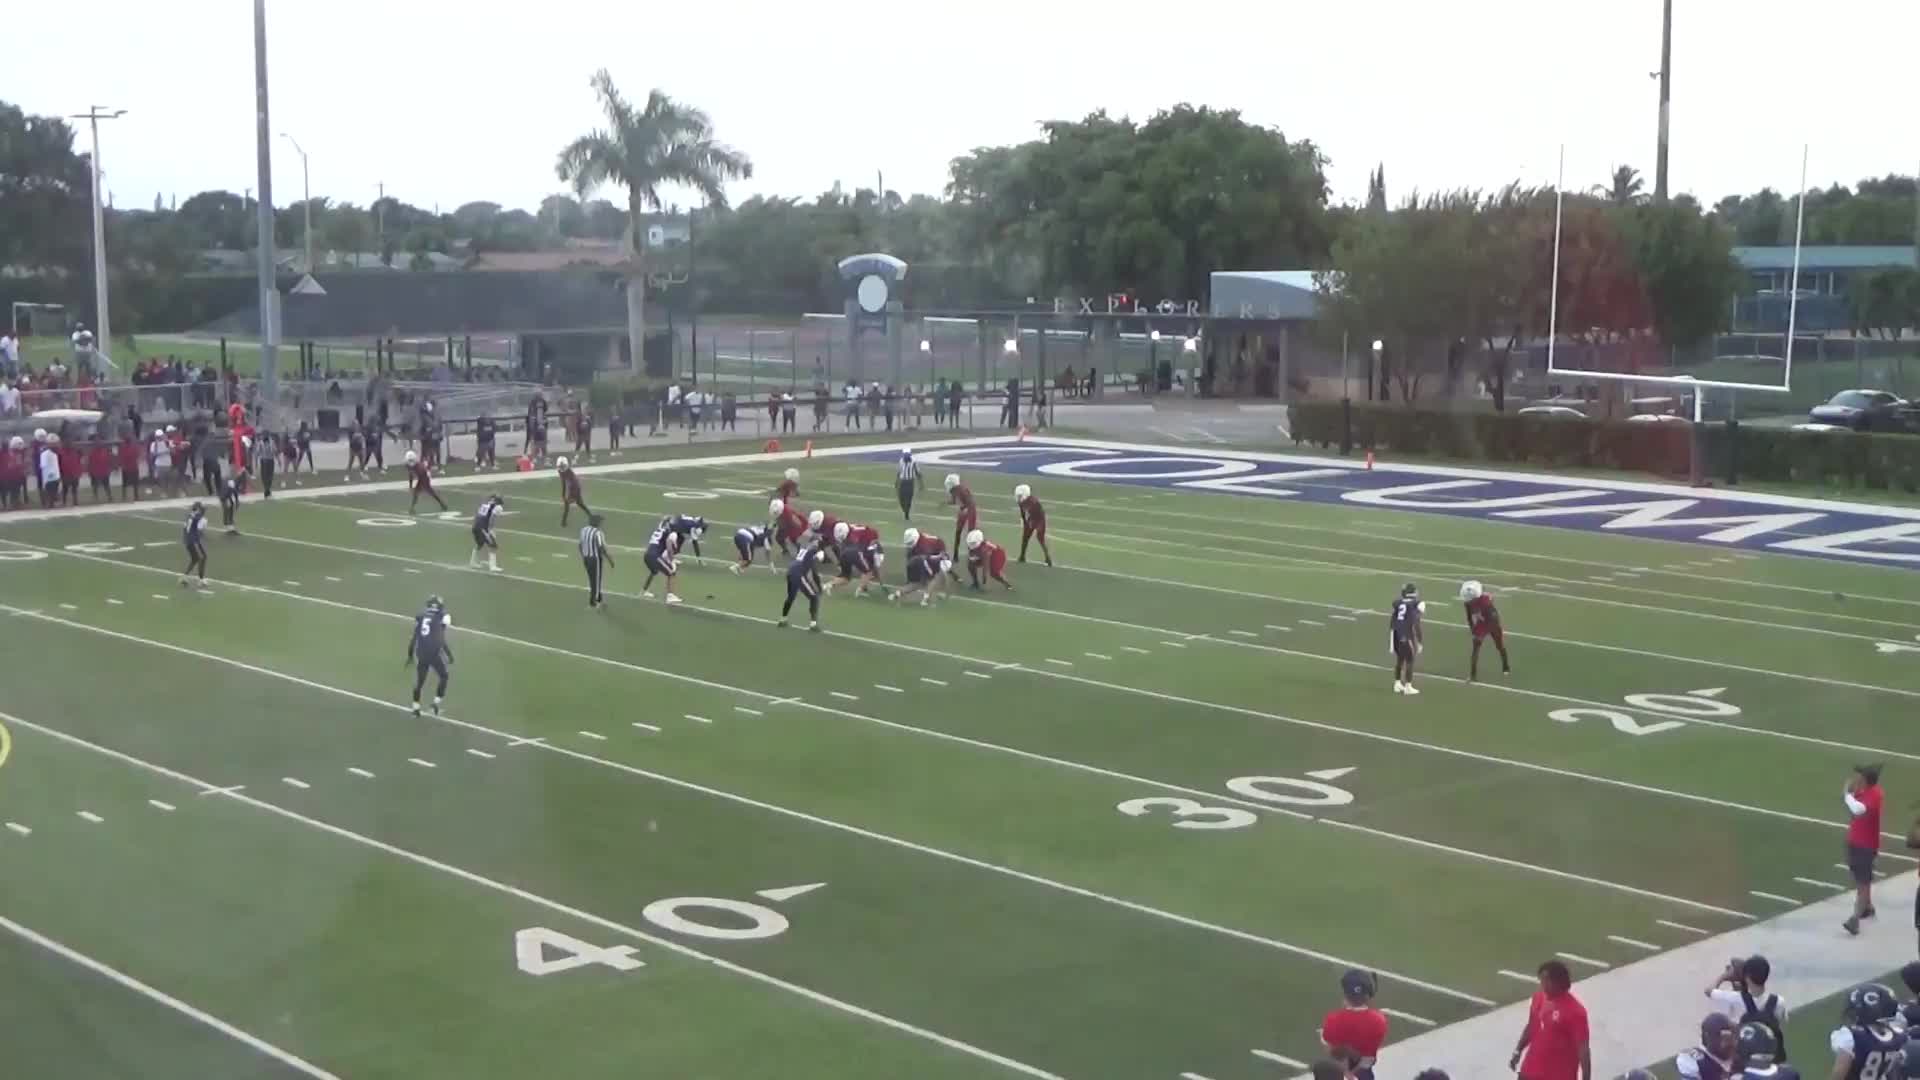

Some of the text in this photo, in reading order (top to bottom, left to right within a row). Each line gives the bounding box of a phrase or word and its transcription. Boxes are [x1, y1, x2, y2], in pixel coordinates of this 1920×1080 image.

[421, 617, 432, 636] 5
[1397, 603, 1407, 620] 2
[1547, 693, 1741, 735] 20
[1116, 776, 1354, 829] 30
[515, 897, 789, 976] 40
[1863, 991, 1880, 1006] C
